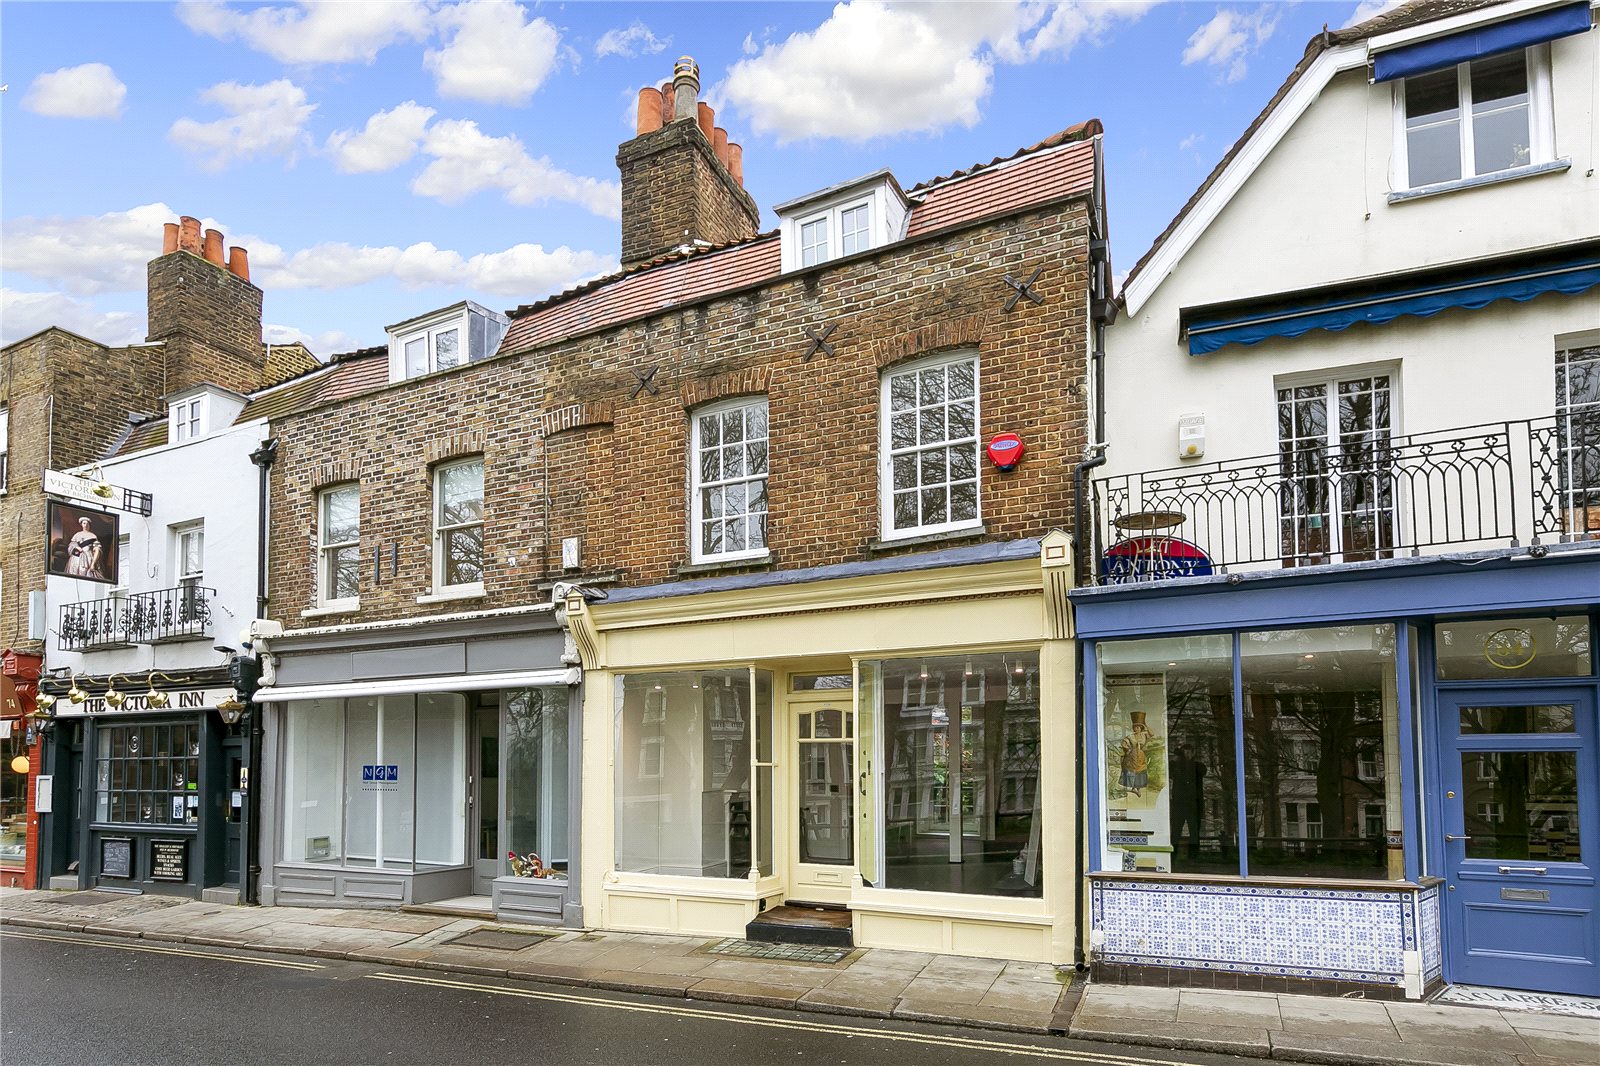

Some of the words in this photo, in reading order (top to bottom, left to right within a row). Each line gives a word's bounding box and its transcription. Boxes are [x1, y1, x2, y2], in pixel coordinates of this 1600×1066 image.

[83, 698, 106, 713] THE
[178, 691, 205, 708] INN
[363, 766, 397, 779] NGM
